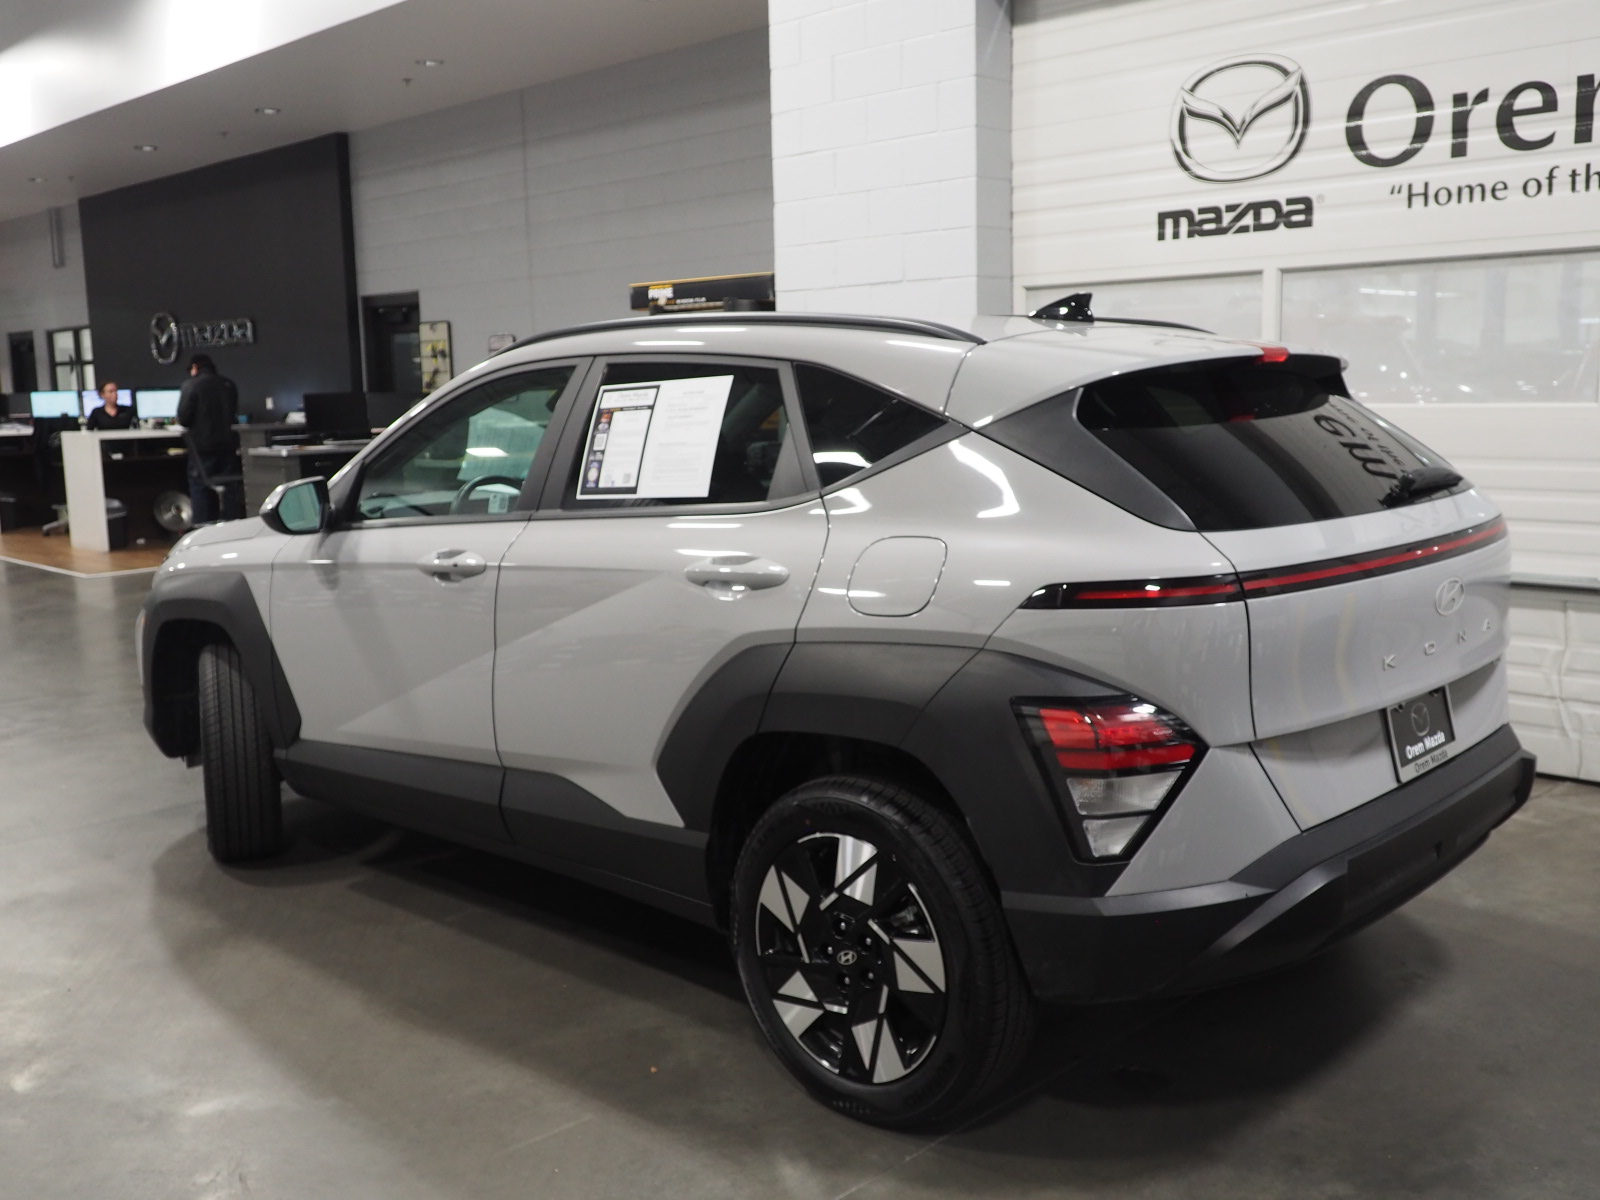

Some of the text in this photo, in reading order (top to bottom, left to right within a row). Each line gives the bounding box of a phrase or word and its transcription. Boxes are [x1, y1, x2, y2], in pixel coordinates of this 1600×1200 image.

[1522, 165, 1560, 198] of
[1382, 618, 1491, 672] KONA
[1405, 731, 1445, 758] Orem Mazda
[1414, 749, 1449, 773] Orem Mazda
